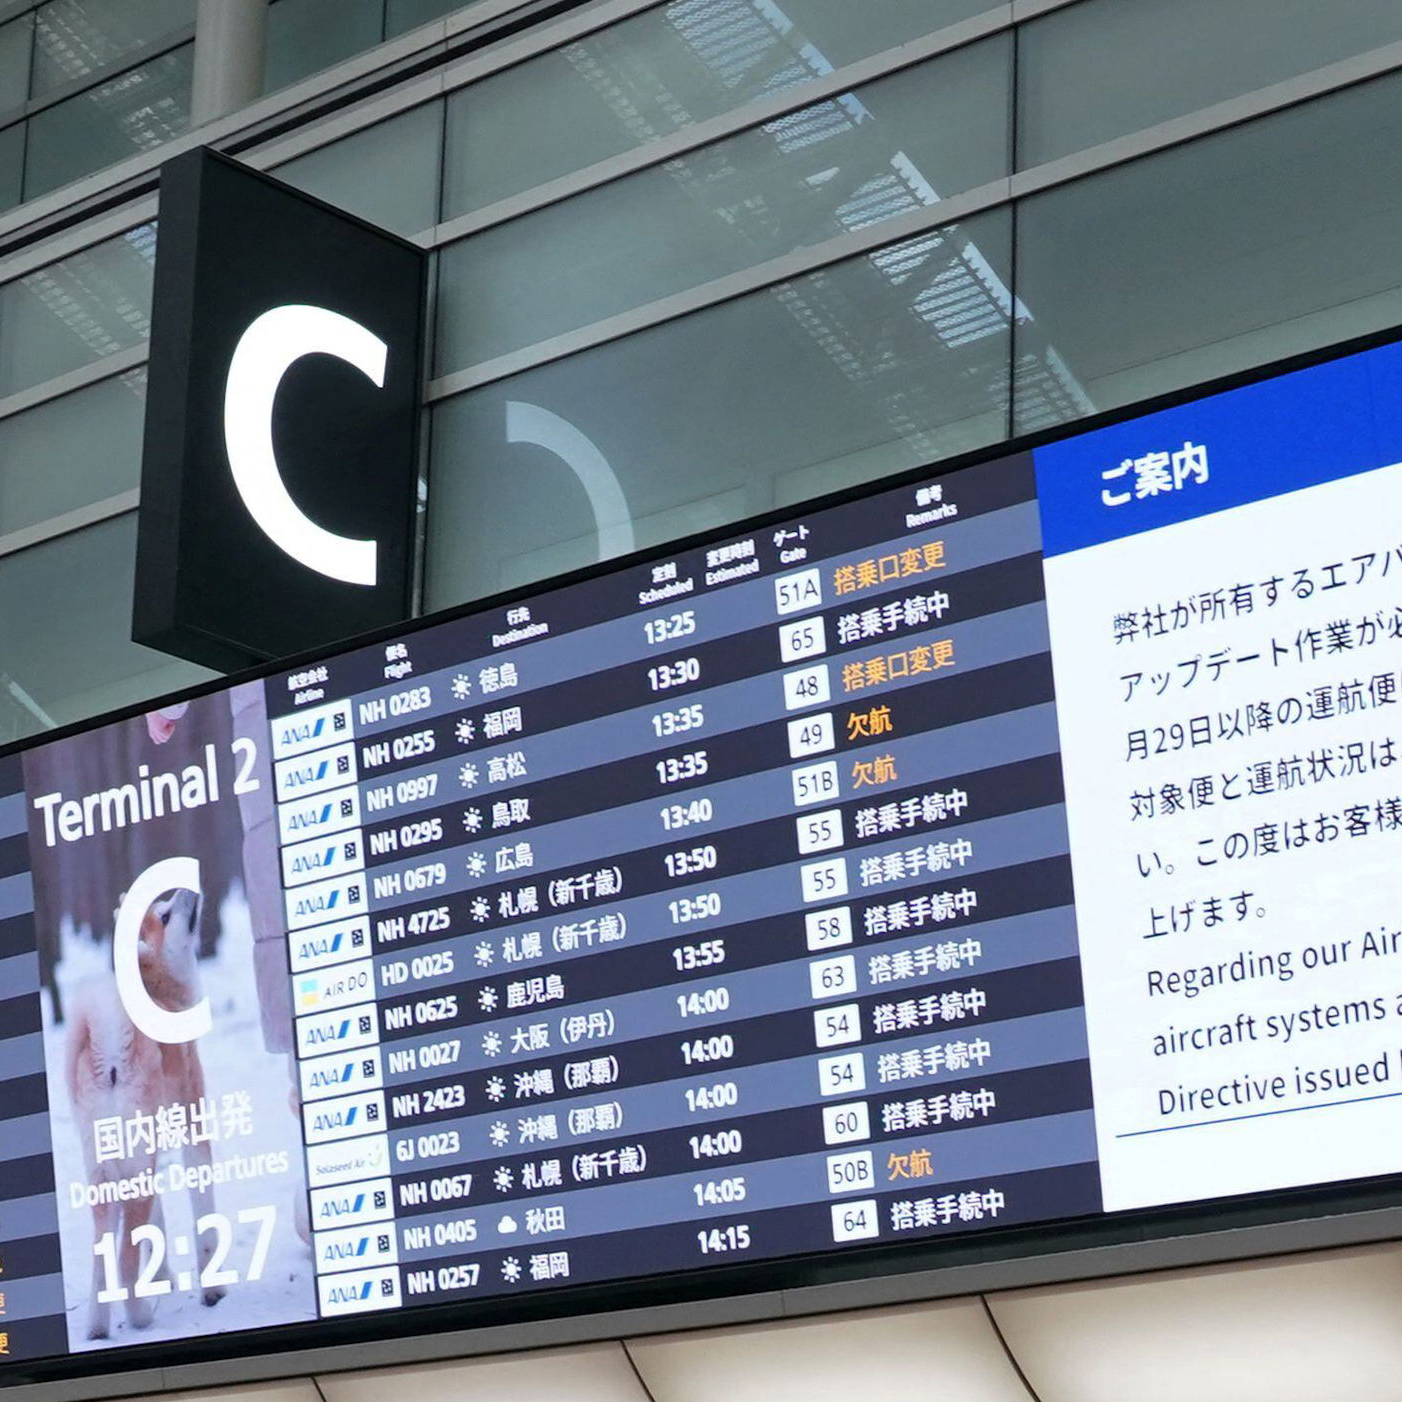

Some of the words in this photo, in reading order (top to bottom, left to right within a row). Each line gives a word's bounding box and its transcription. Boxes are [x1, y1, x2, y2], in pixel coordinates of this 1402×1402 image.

[224, 304, 388, 586] C
[1101, 440, 1209, 507] ご案内
[905, 503, 958, 528] Remarks
[773, 525, 810, 548] ゲート
[779, 546, 807, 564] Gate
[834, 541, 946, 596] 搭乗口変更
[705, 558, 759, 586] Estimated
[638, 577, 694, 605] Scheduled
[779, 579, 818, 607] 51A
[492, 621, 549, 648] Destination
[644, 611, 696, 644] 13:25
[791, 628, 814, 650] 65
[479, 663, 518, 695] 徳島
[648, 658, 700, 691] 13:30
[842, 639, 956, 692] 搭乗口変更
[795, 676, 819, 697] 48
[360, 701, 386, 725] NH
[390, 687, 431, 717] 0283
[483, 706, 523, 739] 福岡
[652, 705, 704, 738] 13:35
[363, 745, 389, 768] NH
[393, 730, 435, 760] 0255
[487, 751, 527, 784] 高松
[798, 770, 834, 798] 51B
[850, 754, 898, 788] 欠航
[33, 743, 220, 848] Terminal
[231, 736, 261, 796] 2
[367, 788, 393, 812] NH
[397, 774, 438, 804] 0997
[660, 798, 713, 831] 13:40
[495, 842, 534, 875] 広島
[374, 875, 400, 899] NH
[404, 863, 446, 892] 0679
[813, 869, 836, 891] 55
[669, 892, 721, 924] 13:50
[1142, 889, 1267, 940] 上げます。
[817, 917, 841, 940] 58
[112, 855, 213, 1045] C
[673, 939, 725, 971] 13:55
[381, 962, 409, 987] HD
[412, 951, 454, 980] 0025
[1147, 950, 1294, 999] Regarding
[1302, 940, 1352, 969] our
[506, 974, 565, 1009] 鹿児島
[385, 1006, 411, 1031] NH
[417, 996, 458, 1025] 0625
[1153, 1013, 1258, 1057] aircraft
[1266, 997, 1386, 1044] systems
[1158, 1070, 1286, 1116] Directive
[1294, 1051, 1389, 1095] issued
[92, 1090, 253, 1164] 国内線出発
[69, 1167, 166, 1210] Domestic
[169, 1149, 289, 1194] Departures
[832, 1160, 869, 1185] 50B
[887, 1148, 933, 1181] 欠航
[693, 1177, 747, 1206] 14:05
[404, 1226, 430, 1250] NH
[434, 1219, 477, 1245] 0405
[525, 1205, 566, 1236] 秋田
[93, 1204, 277, 1304] 12:27
